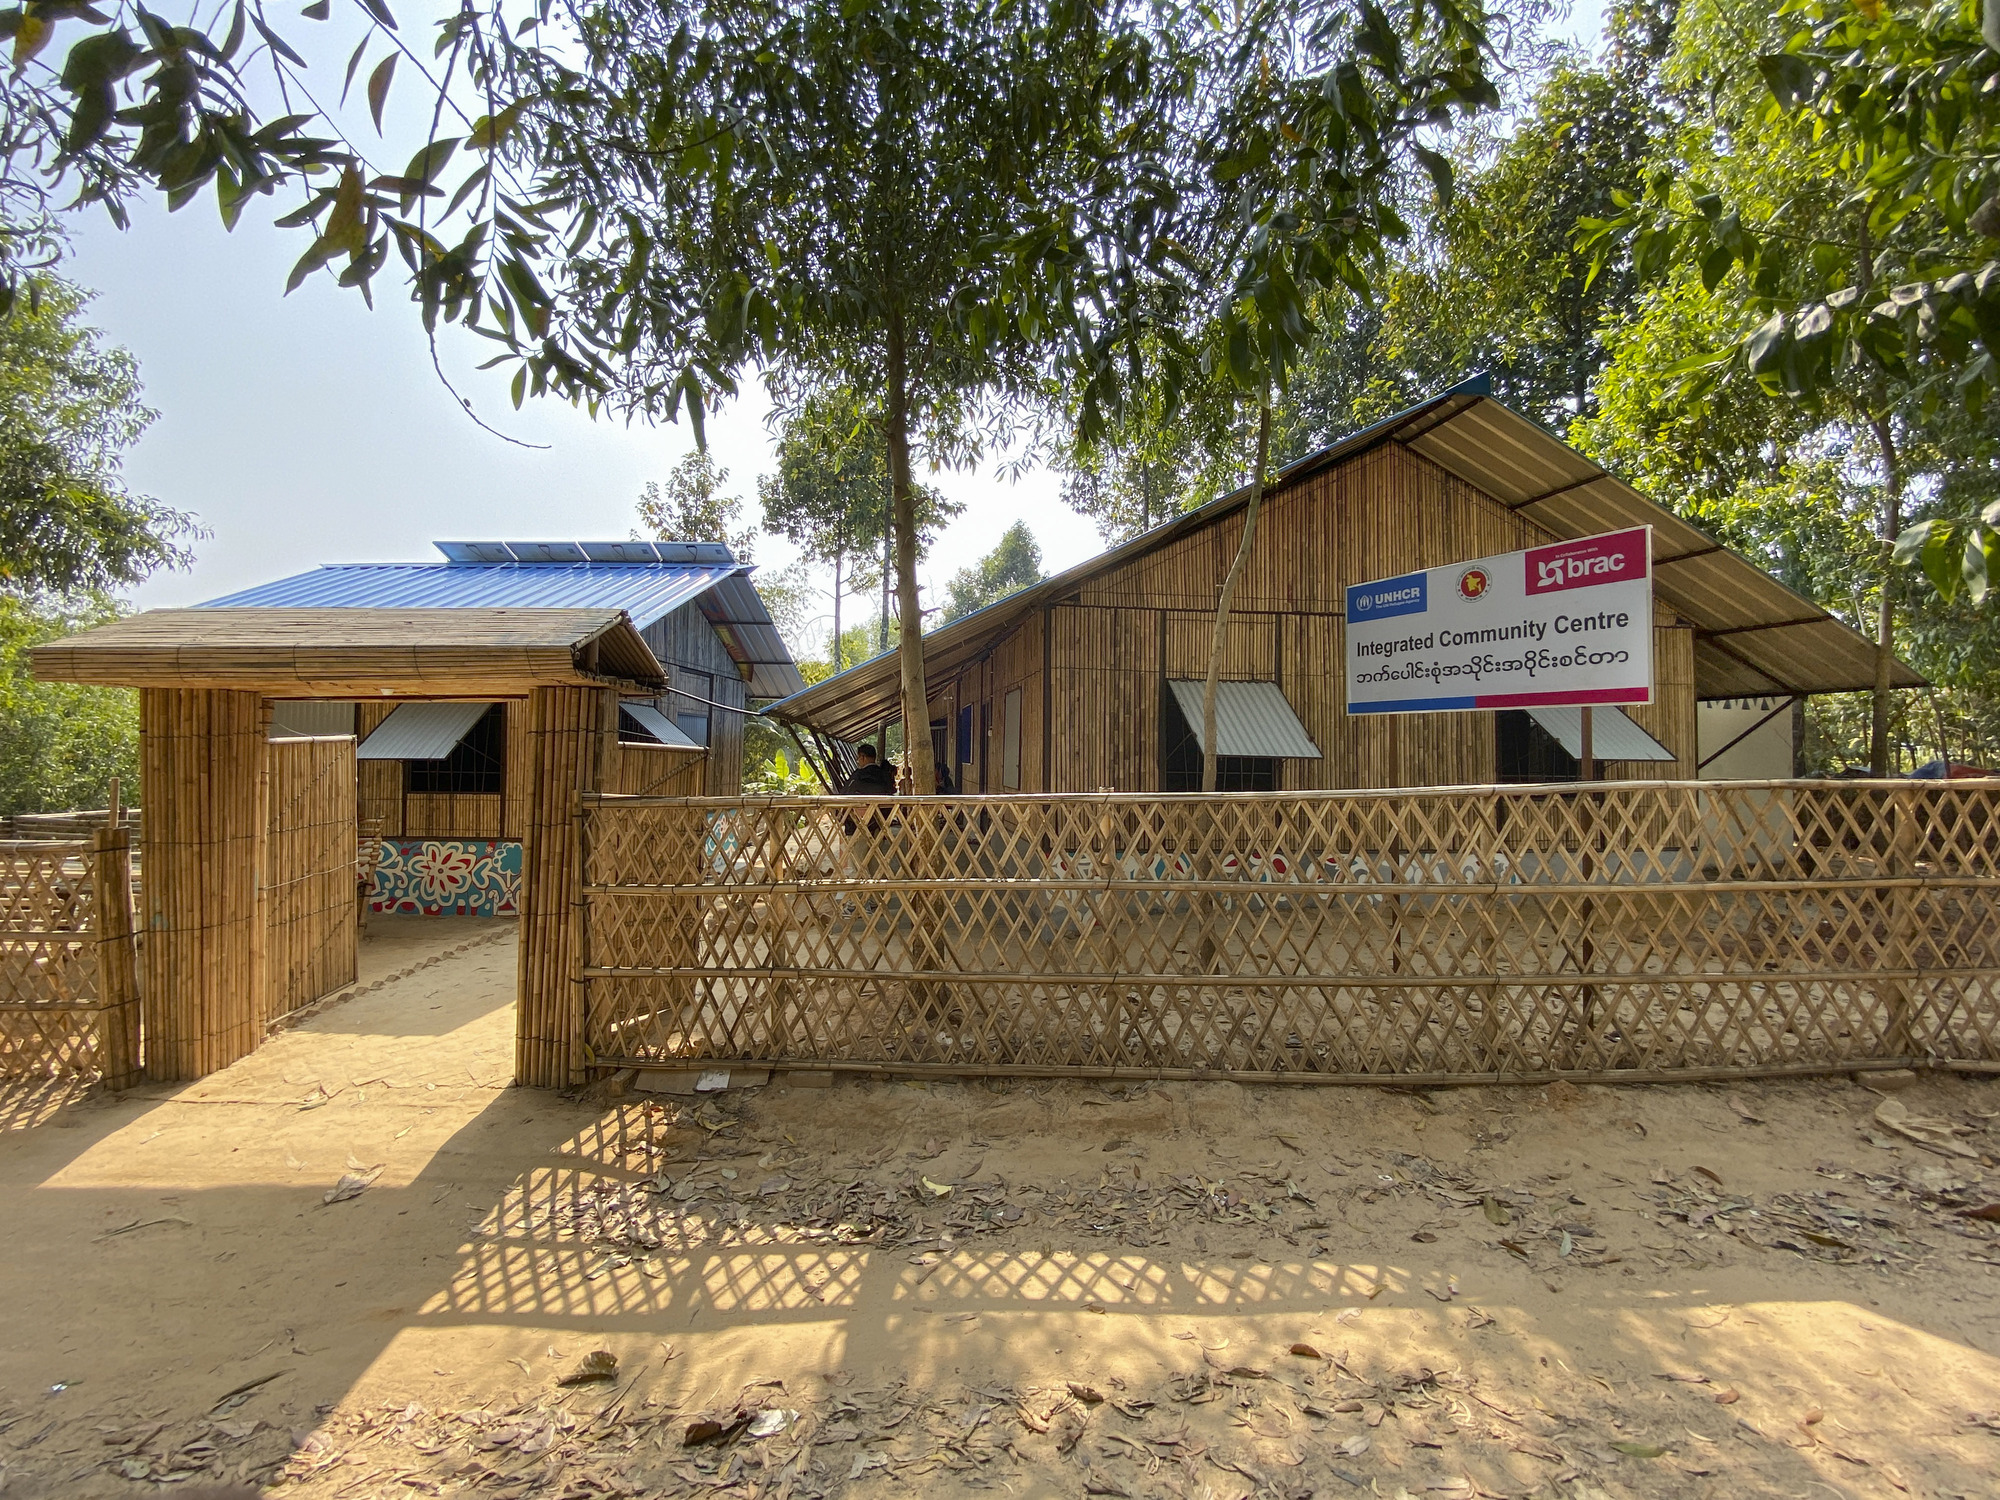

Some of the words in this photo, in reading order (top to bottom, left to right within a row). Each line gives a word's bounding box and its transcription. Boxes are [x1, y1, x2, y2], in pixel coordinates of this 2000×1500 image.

[1567, 553, 1625, 578] brac
[1375, 587, 1420, 605] UNHCR
[1357, 632, 1434, 658] Integrated
[1439, 620, 1547, 647] Community
[1554, 611, 1629, 634] Centre
